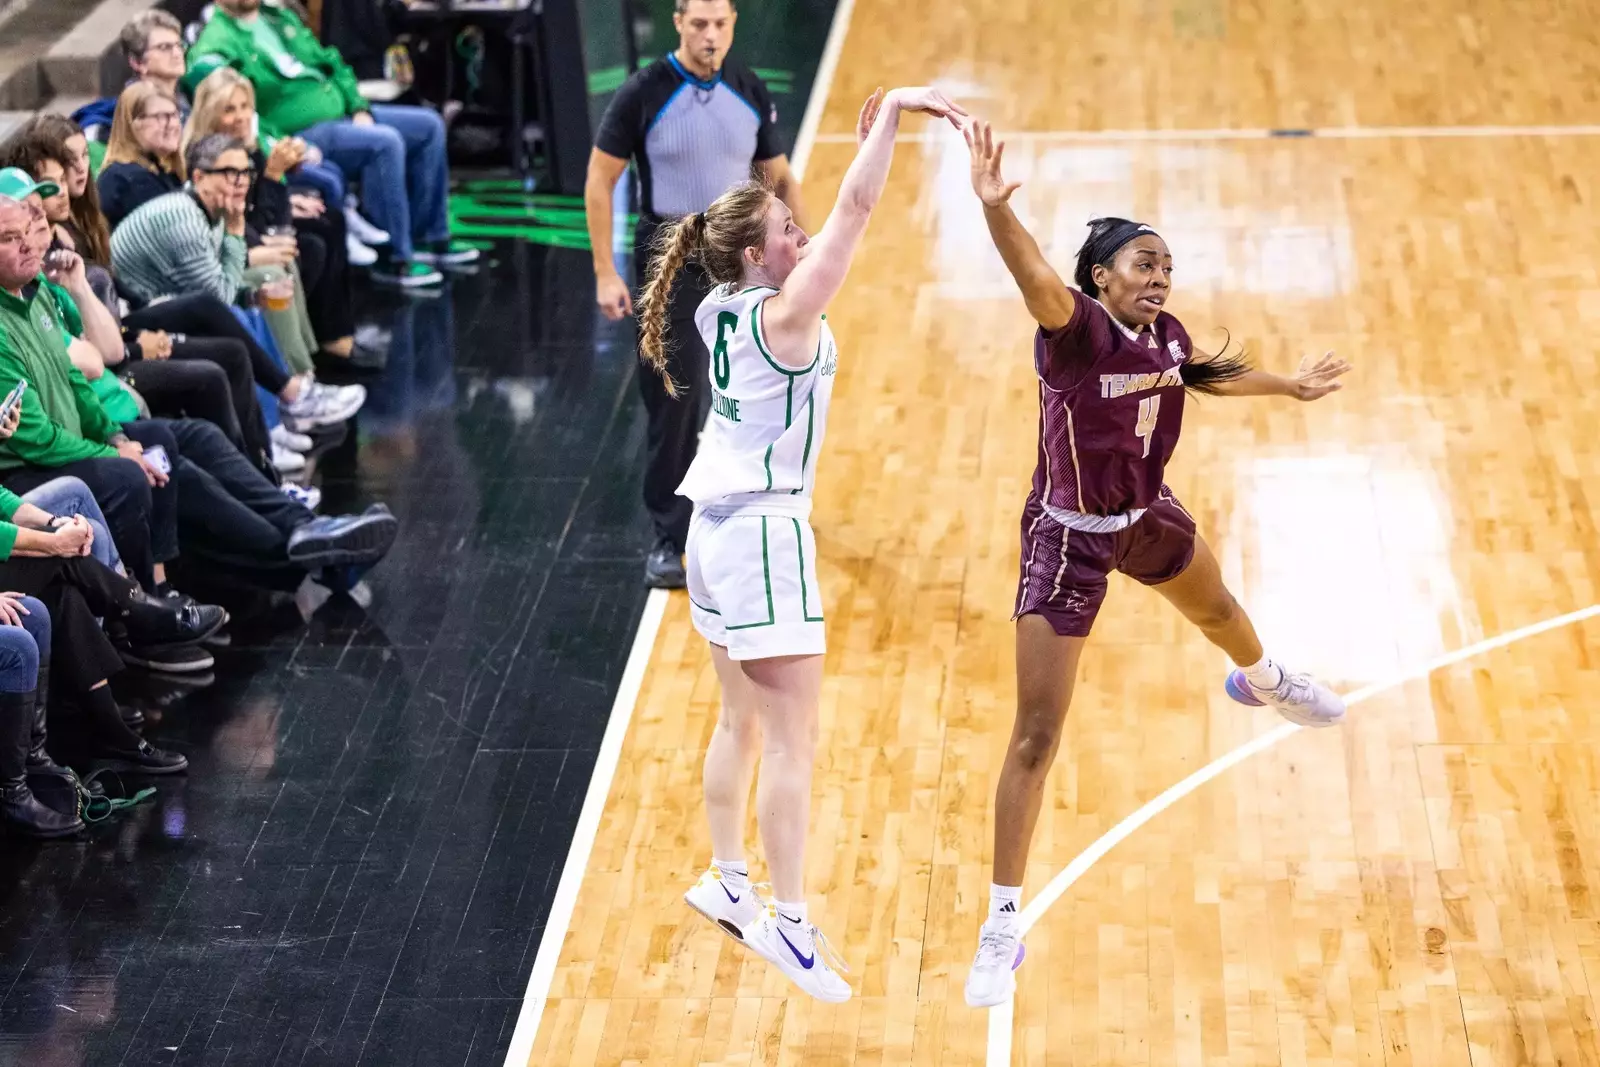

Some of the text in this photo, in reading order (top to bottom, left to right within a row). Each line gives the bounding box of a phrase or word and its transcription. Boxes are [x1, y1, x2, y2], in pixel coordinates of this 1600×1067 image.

[713, 310, 739, 390] 6
[1099, 372, 1161, 399] TEXAS
[1135, 394, 1162, 459] 4
